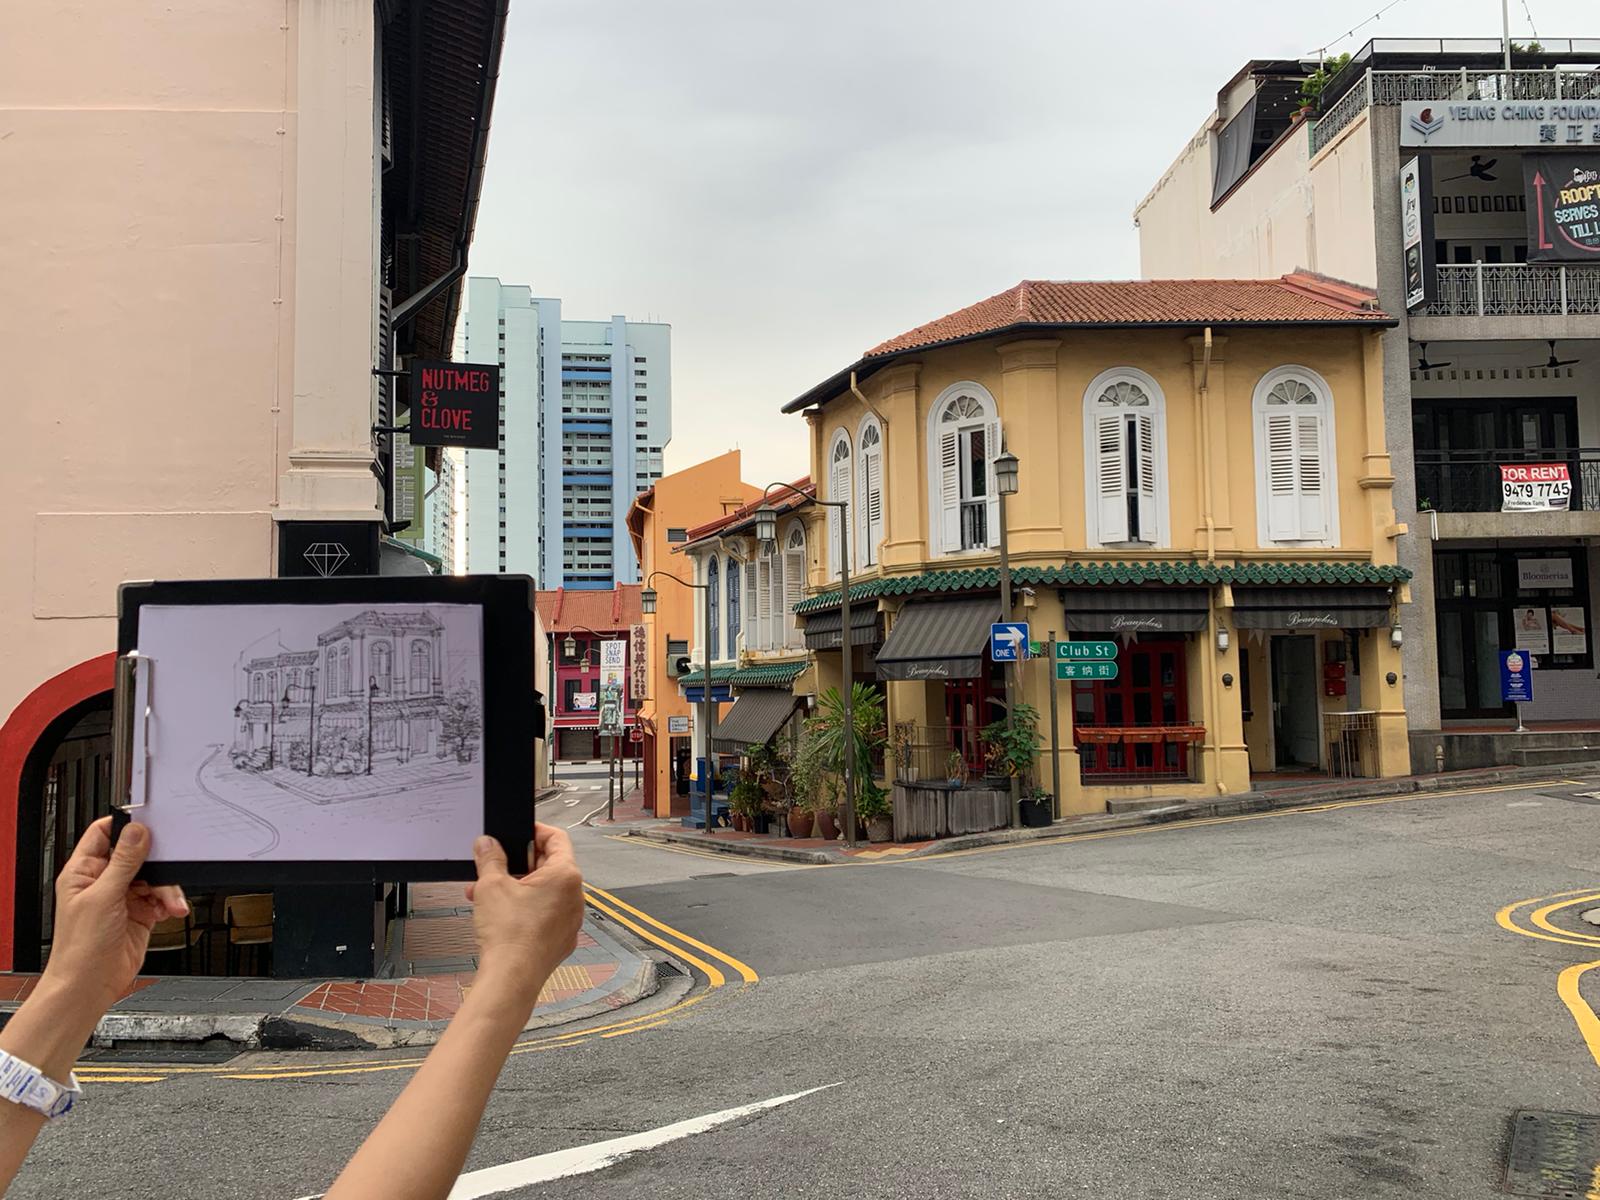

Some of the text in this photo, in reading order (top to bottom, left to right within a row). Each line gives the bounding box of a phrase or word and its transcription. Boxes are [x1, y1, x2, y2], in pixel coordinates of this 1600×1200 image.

[1449, 105, 1496, 120] YEUNG
[1502, 105, 1545, 120] CHING
[1554, 204, 1598, 223] SERVES
[1570, 223, 1593, 238] TILL
[422, 369, 489, 392] NUTMEG
[421, 391, 438, 407] &
[422, 409, 472, 430] CLOVE
[1502, 466, 1567, 480] FOR RENT
[1504, 482, 1569, 497] 9479 7745
[995, 649, 1010, 657] ONE
[1060, 645, 1109, 656] Club St
[1065, 665, 1109, 676] 客纳街
